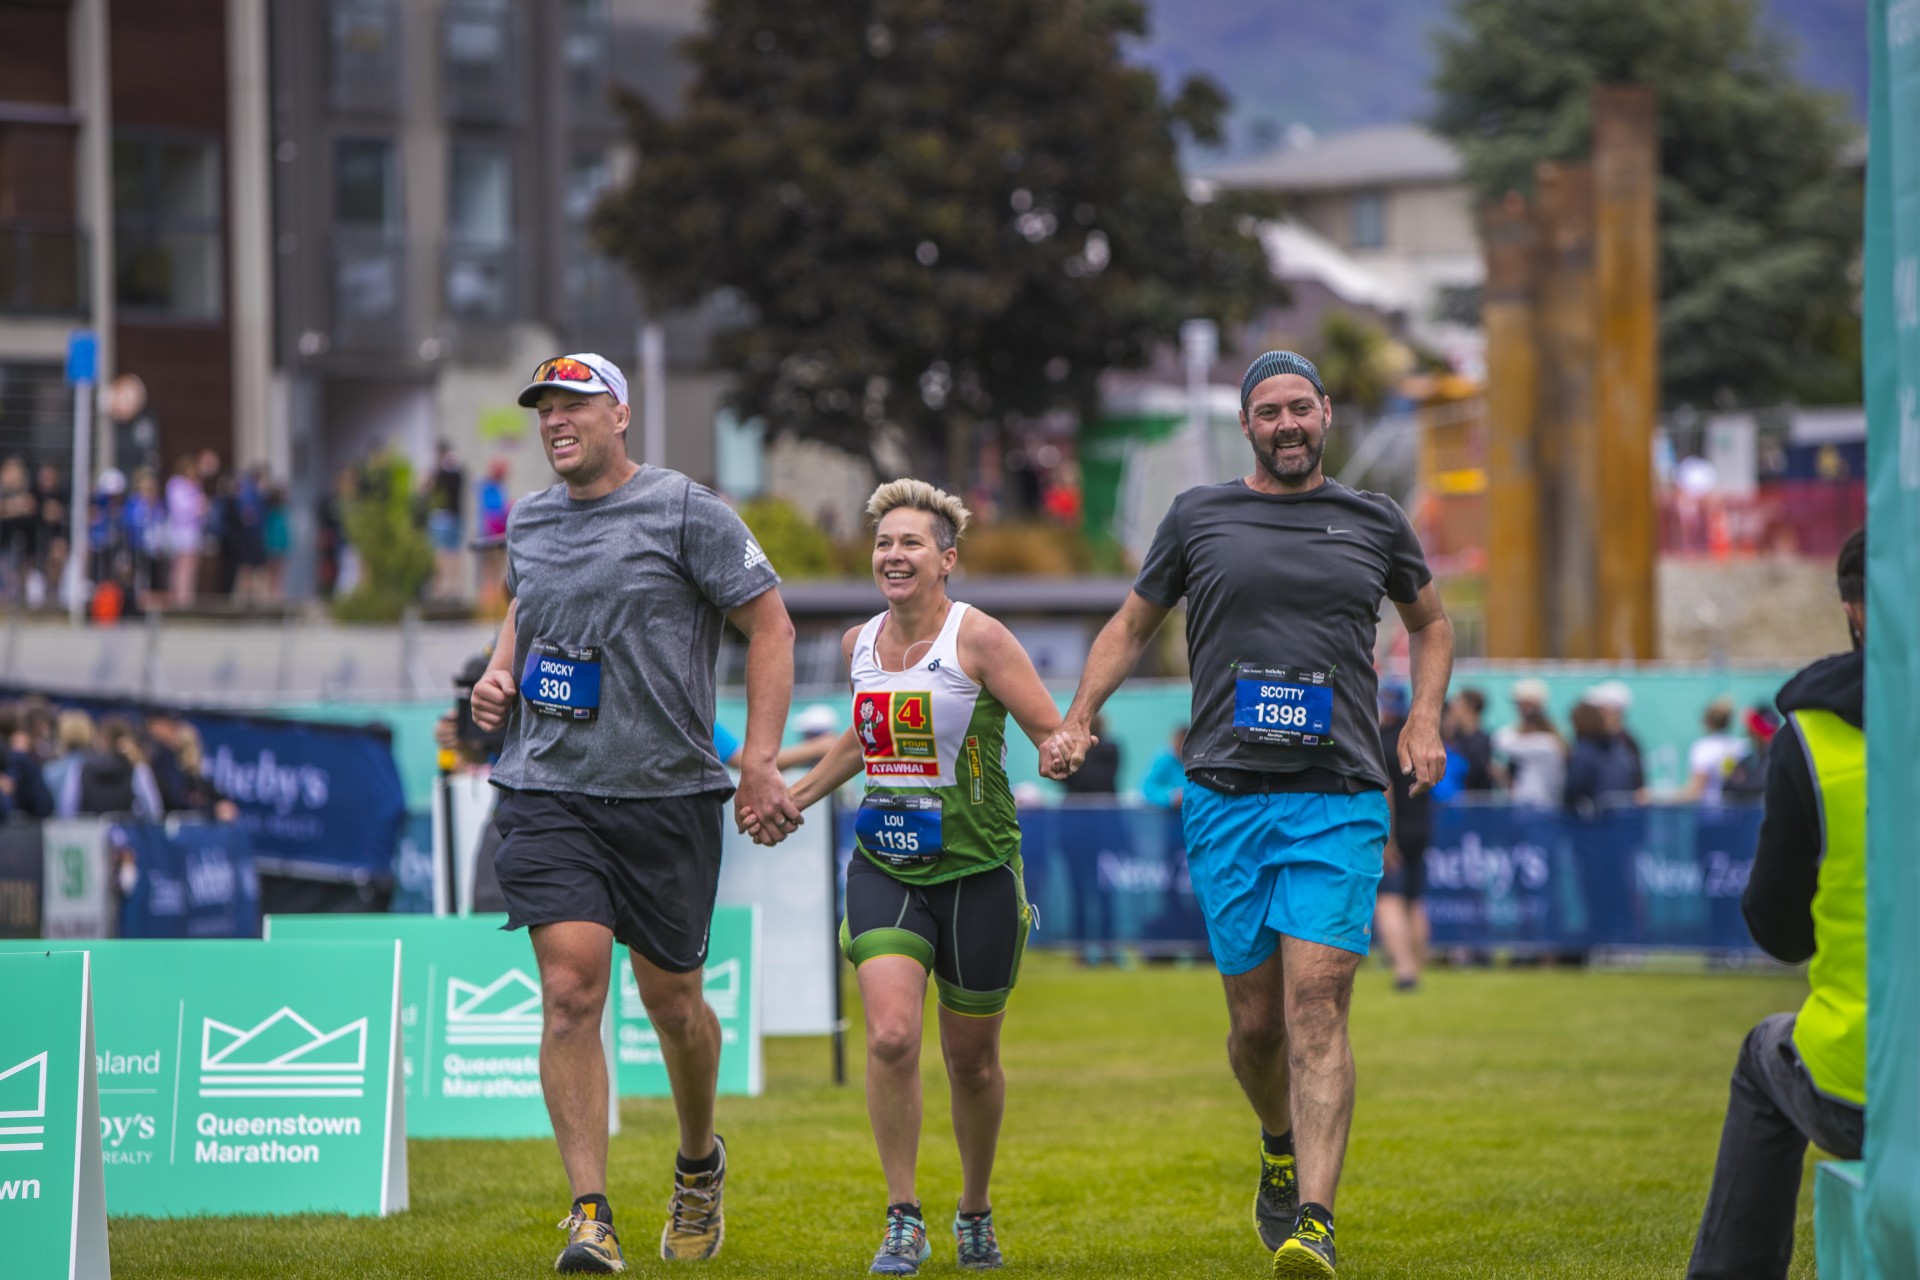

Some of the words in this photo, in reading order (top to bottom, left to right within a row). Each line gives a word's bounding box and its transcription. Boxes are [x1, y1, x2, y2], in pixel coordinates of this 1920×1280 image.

[540, 660, 575, 677] CROCKY
[539, 677, 571, 702] 330
[1260, 685, 1305, 701] SCOTTY
[896, 696, 927, 729] 4
[1255, 702, 1307, 727] 1398
[871, 763, 925, 775] ATAWHAI
[970, 750, 980, 778] FOUR
[884, 815, 904, 827] LOU
[875, 830, 919, 851] 1135
[196, 1112, 361, 1137] Queenstown
[102, 1150, 153, 1165] REALTY
[195, 1140, 320, 1164] Marathon
